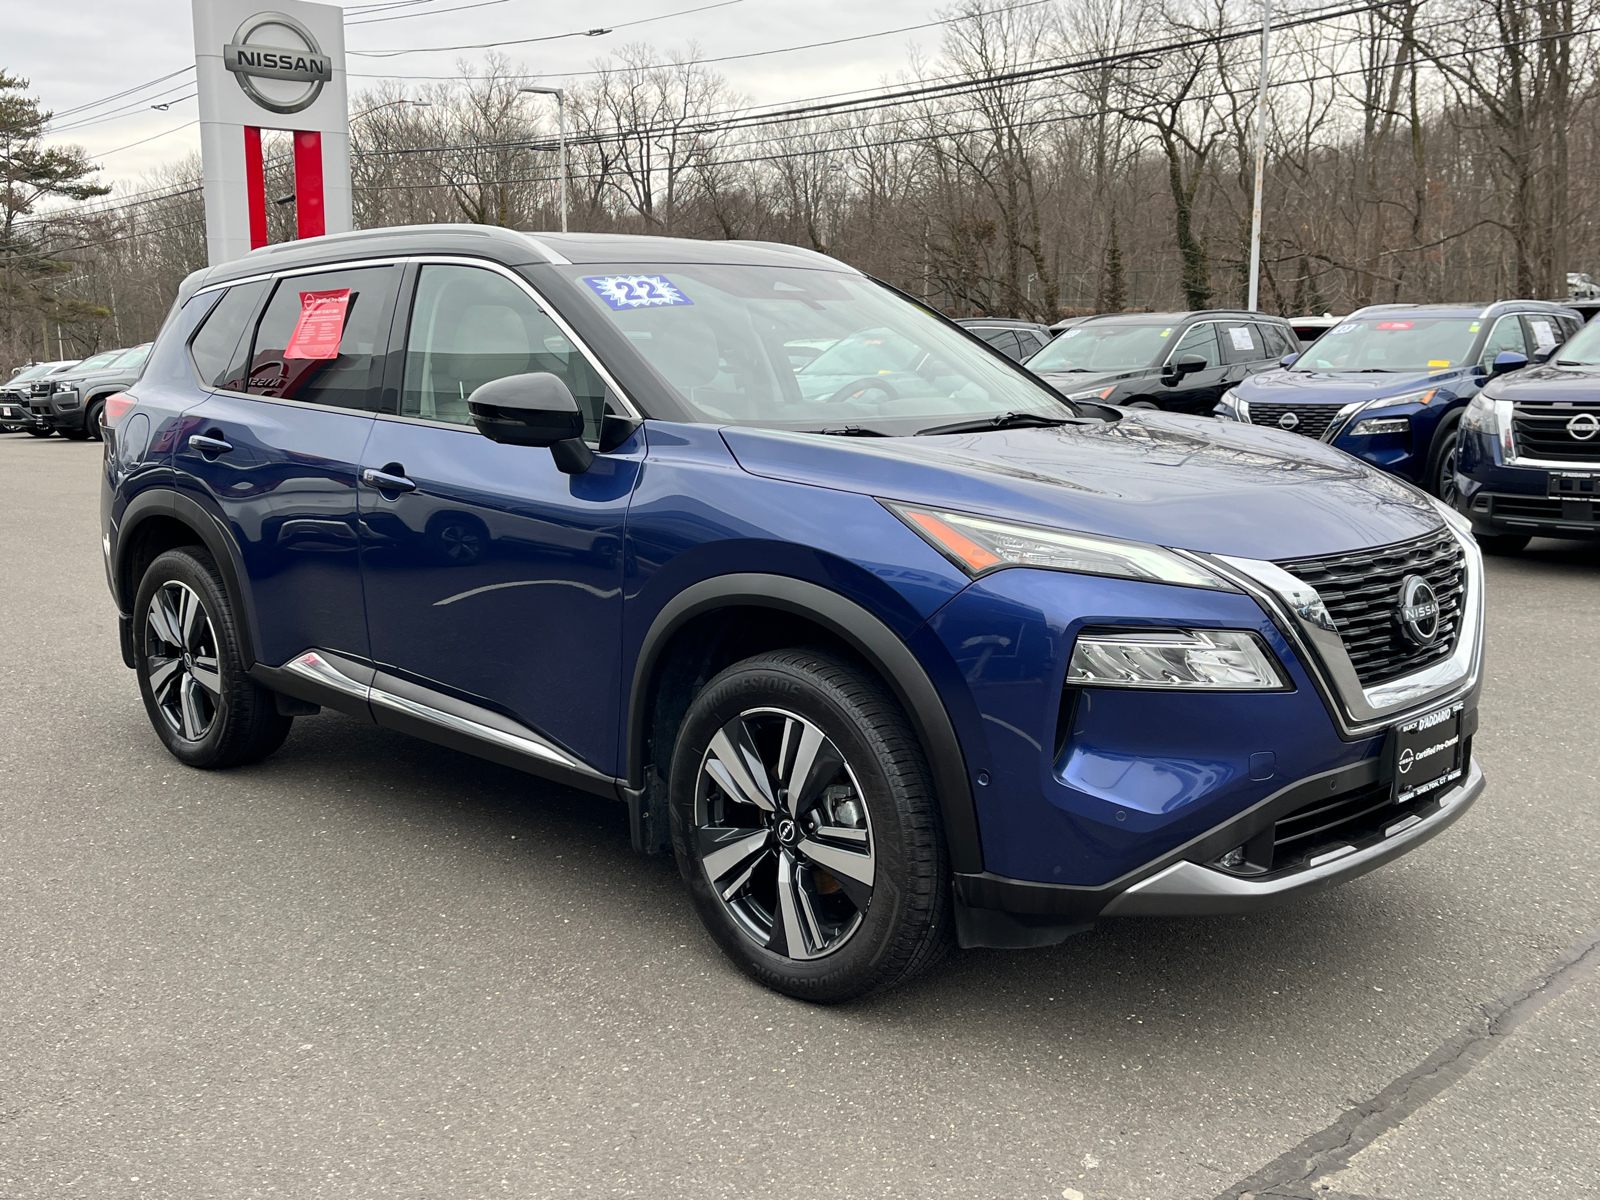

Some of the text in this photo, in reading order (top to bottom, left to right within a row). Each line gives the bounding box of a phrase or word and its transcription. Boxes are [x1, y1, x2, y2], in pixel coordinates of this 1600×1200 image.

[237, 50, 324, 75] NISSAN
[615, 280, 666, 301] 22
[1405, 603, 1439, 620] NISSAN
[1403, 722, 1418, 732] BUICK
[1419, 709, 1451, 731] D'ADDARIO
[1416, 746, 1435, 760] Certified
